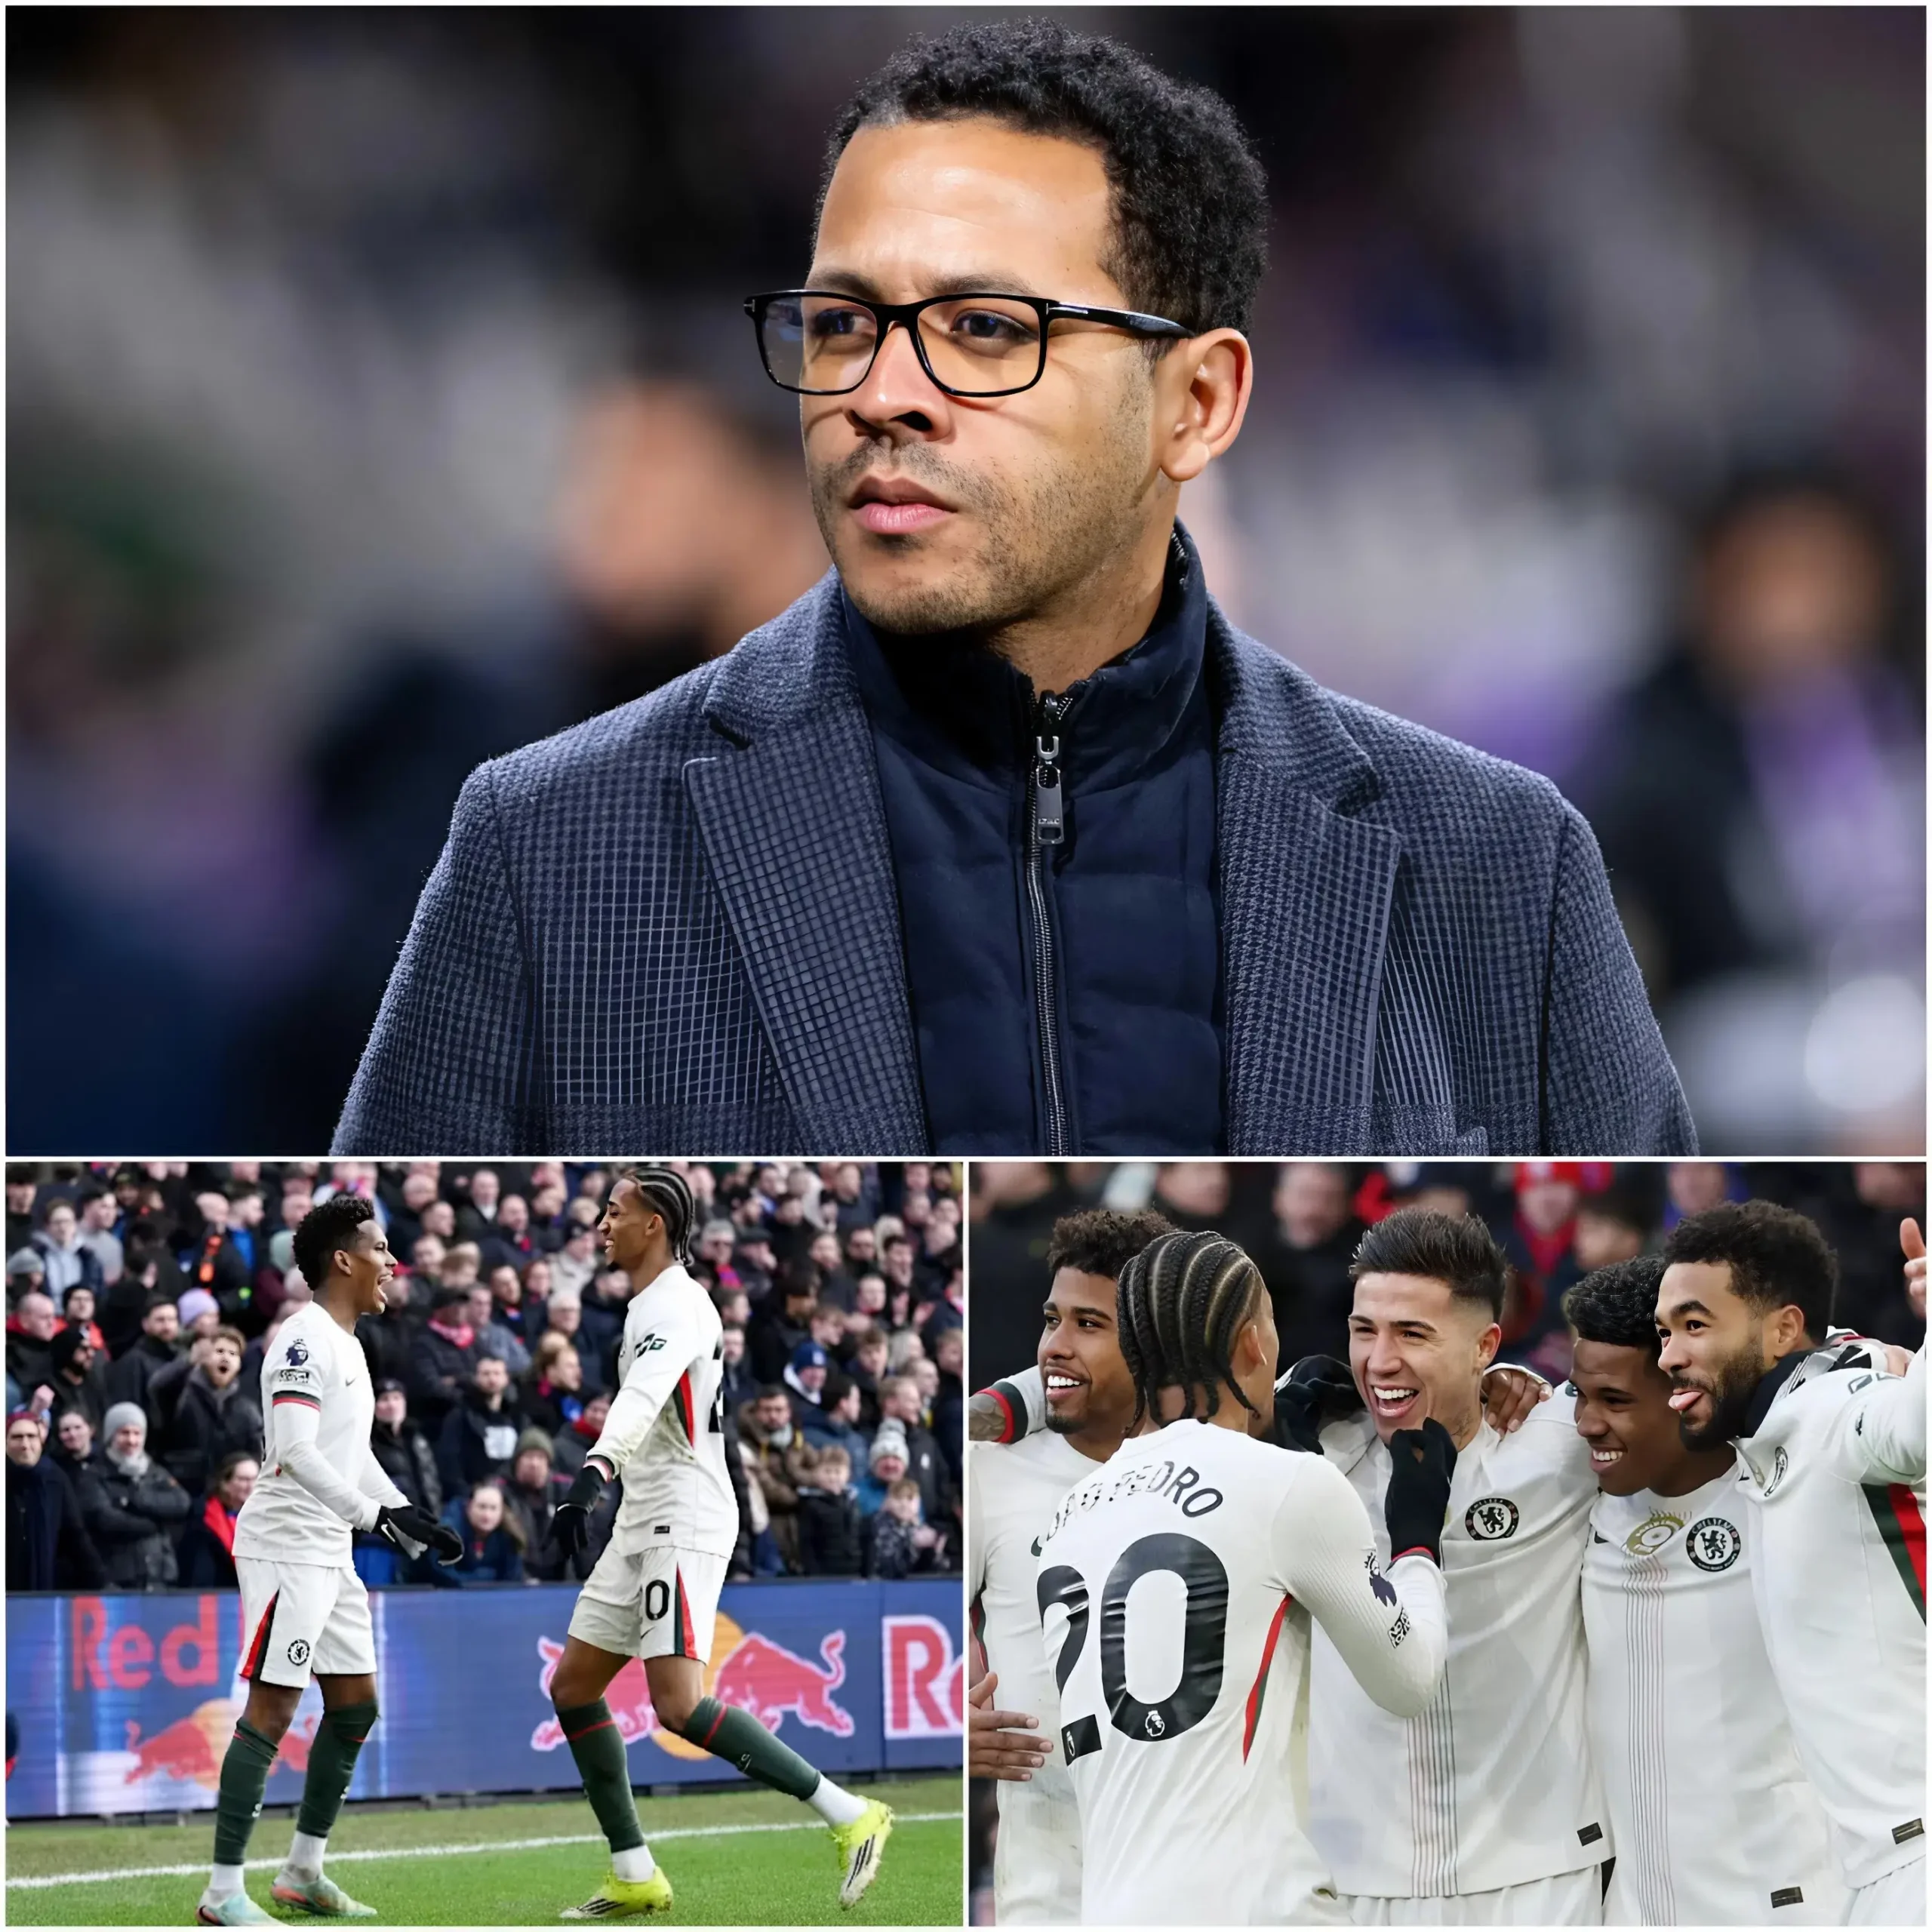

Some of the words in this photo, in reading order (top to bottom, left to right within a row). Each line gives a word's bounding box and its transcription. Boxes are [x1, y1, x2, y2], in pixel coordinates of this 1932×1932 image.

[72, 1594, 219, 1691] Red
[641, 1580, 669, 1621] 0
[1037, 1533, 1229, 1767] 20
